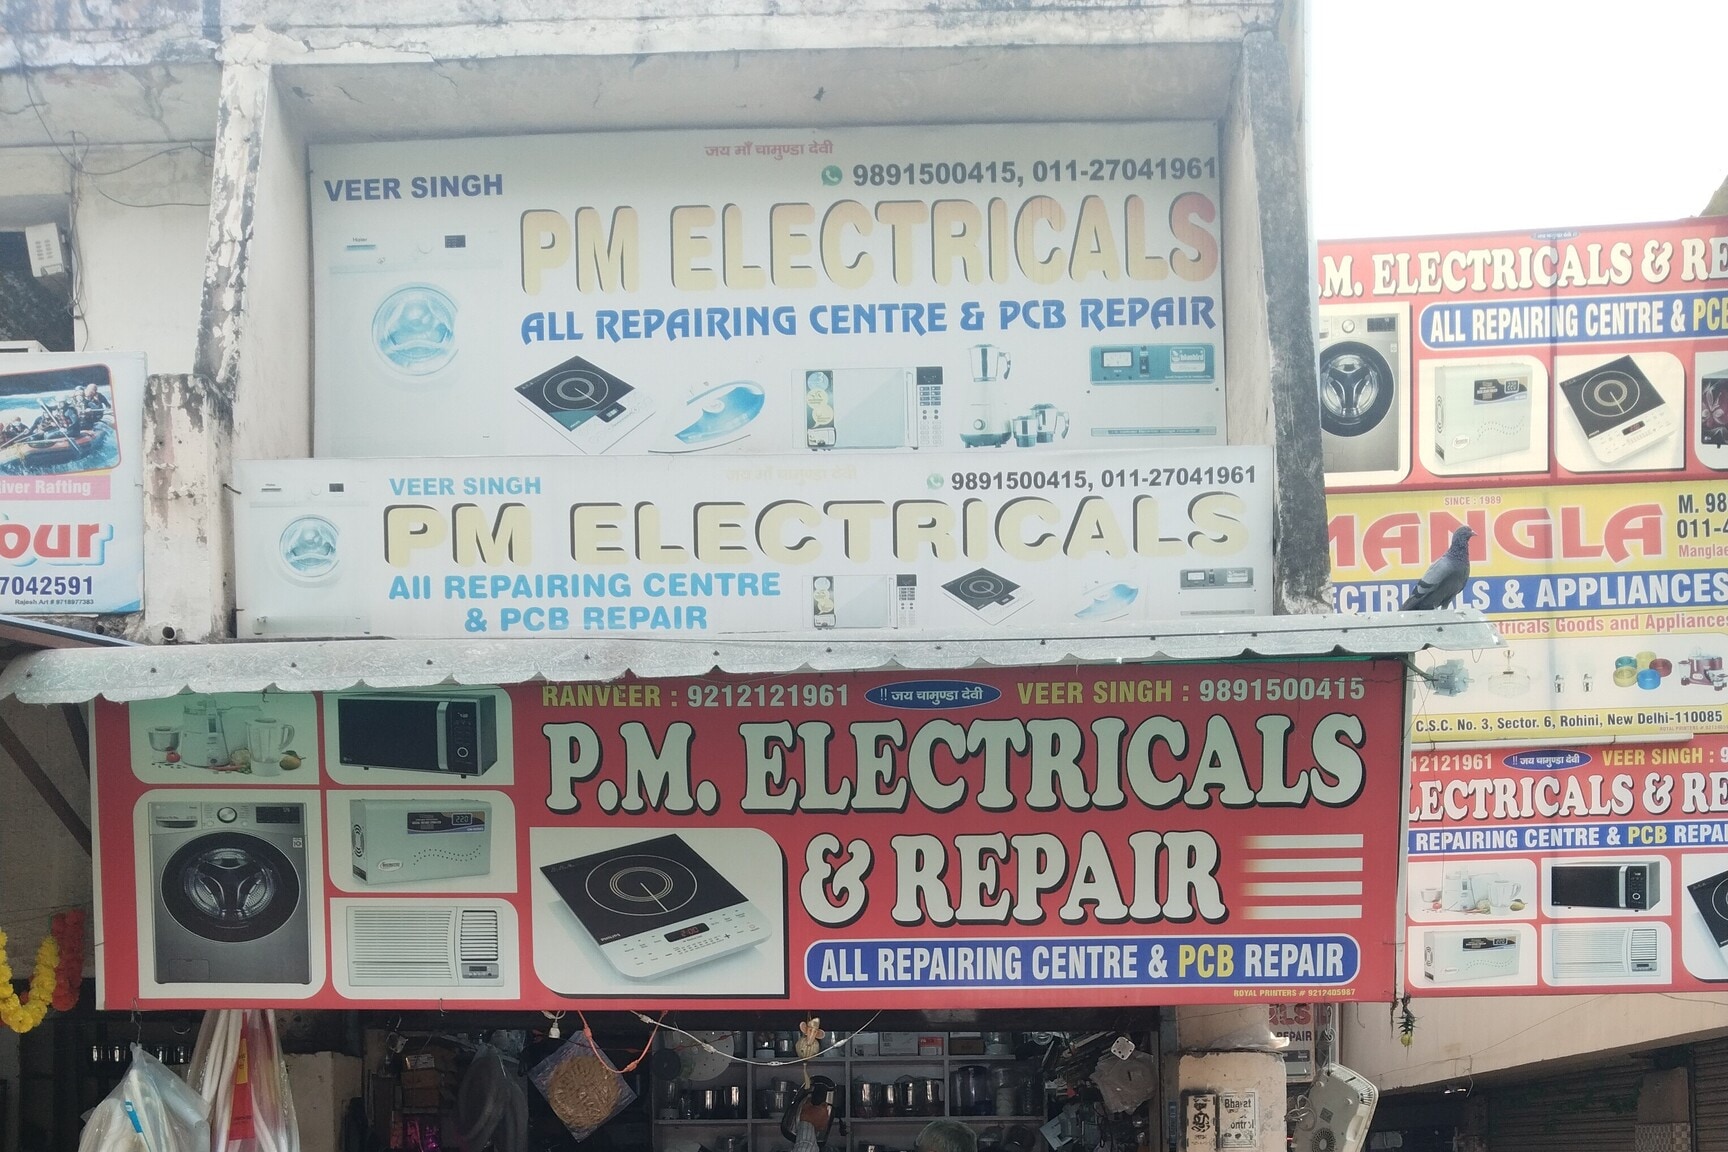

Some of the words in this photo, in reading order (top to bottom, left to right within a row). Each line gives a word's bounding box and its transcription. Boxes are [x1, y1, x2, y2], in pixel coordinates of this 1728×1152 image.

[705, 145, 730, 157] जय
[755, 143, 804, 160] चामुण्डा
[809, 140, 833, 154] देवी
[852, 161, 1024, 187] 9891500415,
[1032, 156, 1216, 182] 011-27041961
[324, 177, 402, 202] VEER
[410, 173, 503, 200] SINGH
[519, 205, 639, 296] PM
[670, 190, 1218, 292] ELECTRICALS
[1371, 241, 1633, 295] ELECTRICALS
[1641, 238, 1674, 283] &
[520, 310, 584, 346] ALL
[595, 305, 797, 343] REPAIRING
[809, 302, 948, 337] CENTRE
[960, 301, 985, 332] &
[999, 299, 1067, 331] PCB
[1079, 295, 1217, 332] REPAIR
[1430, 309, 1466, 343] ALL
[1472, 303, 1579, 341] REPAIRING
[1585, 300, 1664, 336] CENTRE
[1670, 298, 1686, 333] &
[0, 480, 30, 494] iver
[35, 479, 92, 496] Rafting
[389, 477, 456, 496] VEER
[463, 475, 542, 495] SINGH
[951, 469, 1094, 492] 9891500415,
[1101, 465, 1256, 488] 011-27041961
[1444, 496, 1472, 506] SINCE
[1479, 495, 1502, 505] 1989
[1678, 494, 1700, 514] M.
[383, 502, 532, 568] PM
[569, 491, 1249, 566] ELECTRICALS
[0, 575, 92, 596] 7042591
[444, 572, 631, 600] REPAIRING
[643, 571, 780, 597] CENTRE
[1502, 578, 1525, 609] &
[1537, 571, 1728, 607] APPLIANCES
[464, 607, 488, 633] &
[500, 606, 570, 632] PCB
[583, 605, 708, 631] REPAIR
[1494, 617, 1550, 636] tricals
[1555, 616, 1605, 633] Goods
[1609, 614, 1640, 631] and
[541, 684, 661, 707] RANVEER
[687, 684, 848, 707] 9212121961
[891, 690, 914, 701] जय
[916, 690, 958, 705] चामुण्डा
[961, 687, 984, 700] देवी
[1017, 681, 1084, 705] VEER
[1093, 680, 1173, 703] SINGH
[1199, 677, 1366, 702] 9891500415
[1416, 719, 1453, 732] C.S.C.
[1457, 718, 1477, 731] No.
[1481, 718, 1493, 732] 3,
[1497, 717, 1540, 730] Sector.
[1544, 716, 1556, 730] 6,
[1560, 714, 1603, 728] Rohini,
[1608, 713, 1633, 726] New
[1638, 710, 1723, 725] Delhi-110085
[542, 719, 720, 815] P.M.
[738, 711, 1367, 815] ELECTRICALS
[1536, 756, 1564, 768] चामुण्डा
[1565, 754, 1580, 764] देवी
[1602, 749, 1646, 767] VEER
[1651, 747, 1703, 765] SINGH
[1642, 771, 1674, 815] &
[1416, 829, 1518, 851] REPAIRING
[1525, 827, 1600, 849] CENTRE
[1606, 826, 1621, 845] &
[1627, 825, 1668, 844] PCB
[800, 832, 875, 928] &
[891, 829, 1229, 927] REPAIR
[820, 947, 869, 983] ALL
[878, 945, 1023, 982] REPAIRING
[1032, 945, 1138, 980] CENTRE
[1148, 945, 1169, 979] &
[1178, 943, 1235, 979] PCB
[1245, 943, 1344, 977] REPAIR
[1233, 989, 1257, 997] ROYAL
[1259, 989, 1297, 997] PRINTERS
